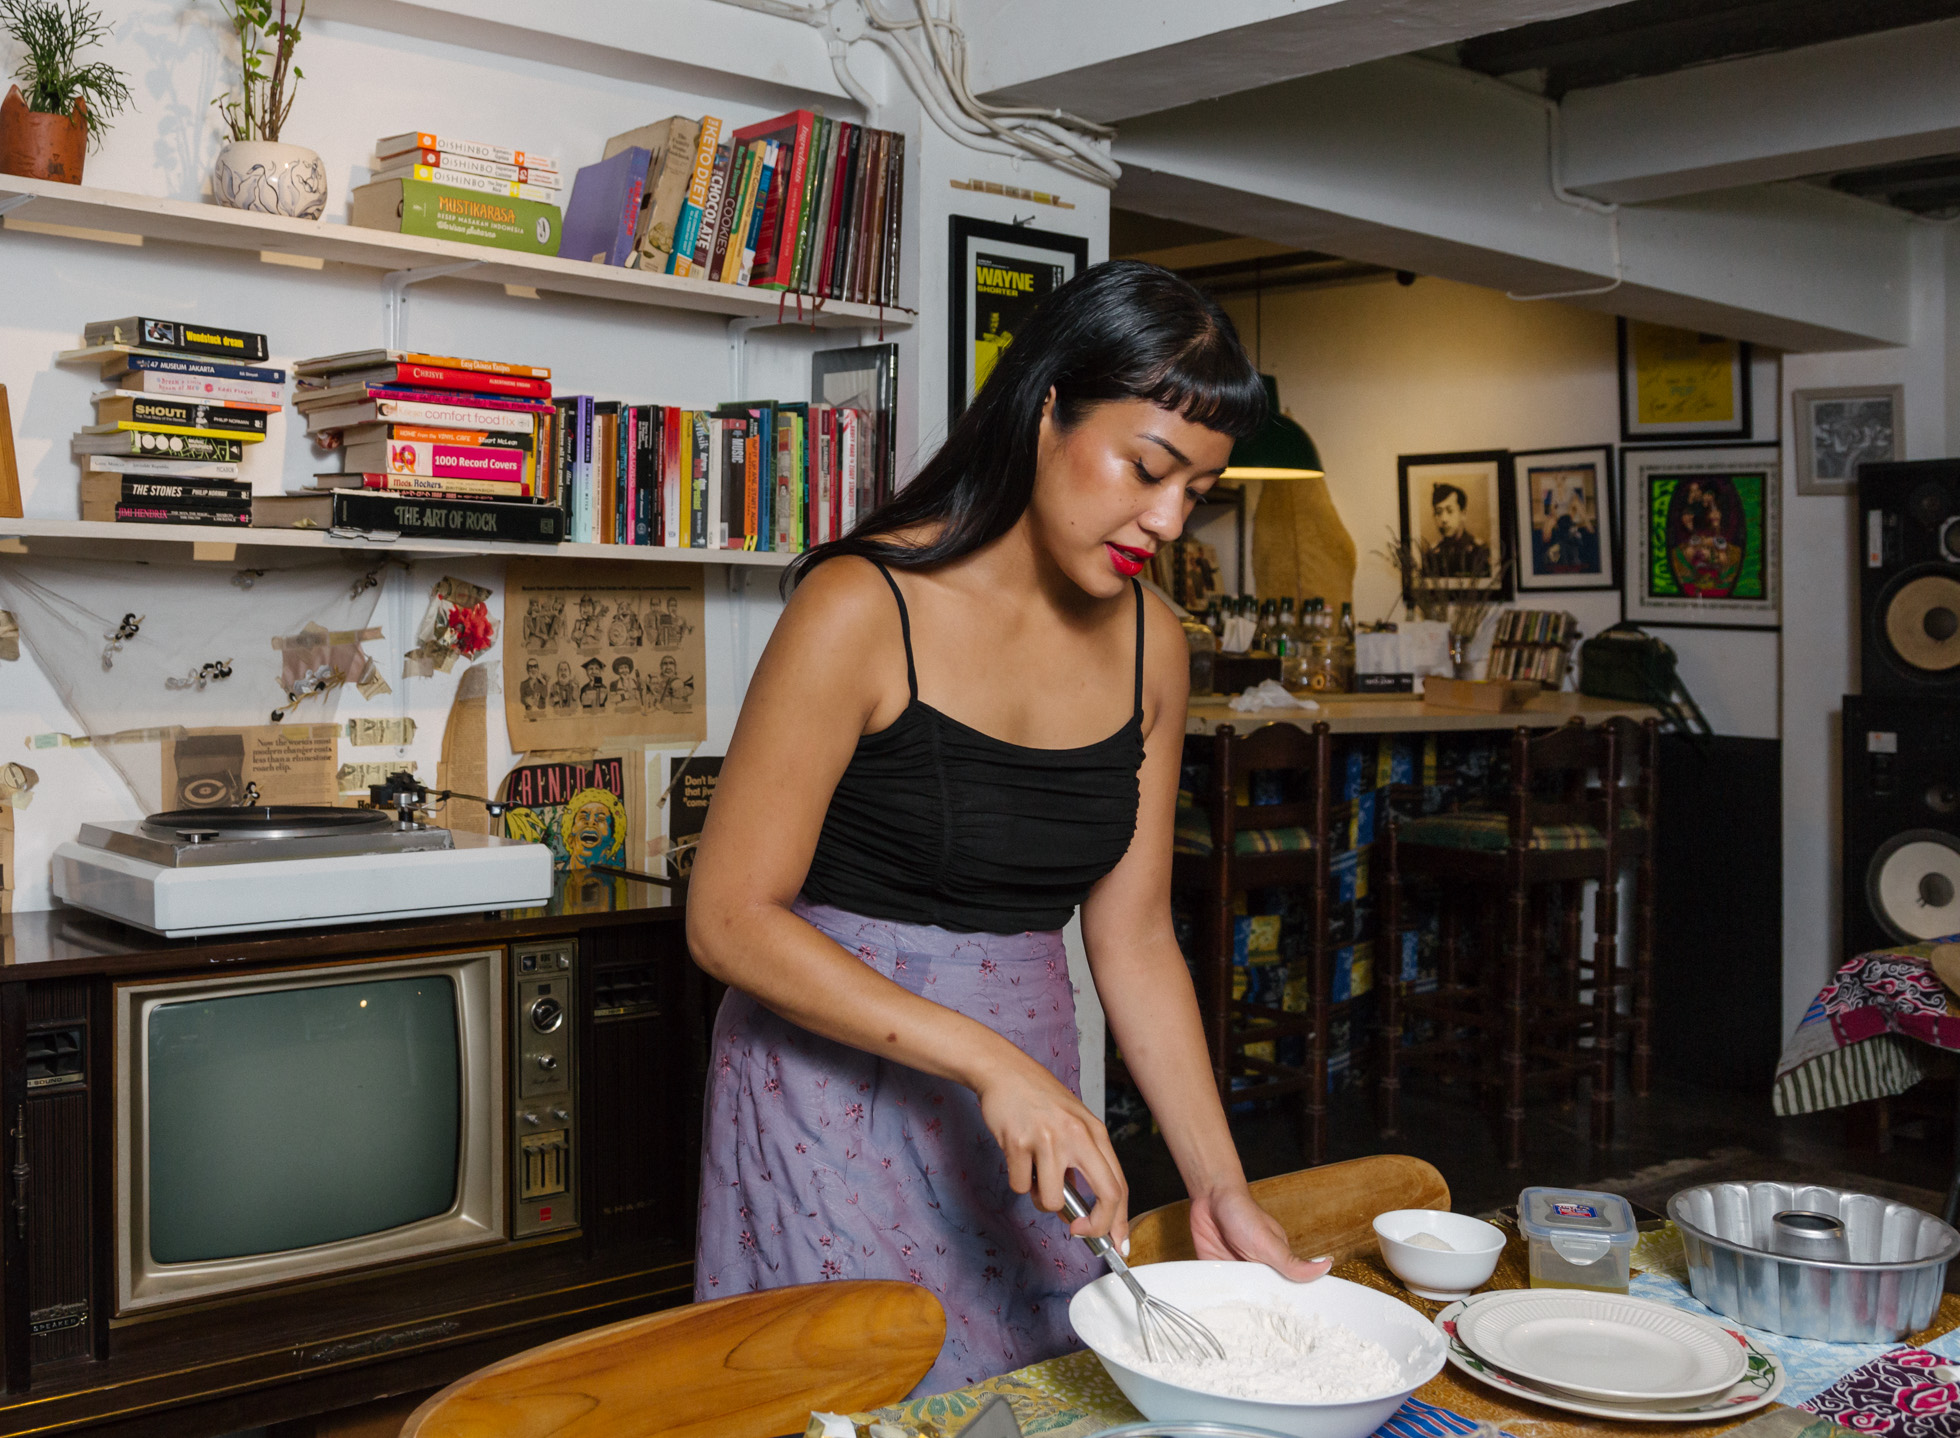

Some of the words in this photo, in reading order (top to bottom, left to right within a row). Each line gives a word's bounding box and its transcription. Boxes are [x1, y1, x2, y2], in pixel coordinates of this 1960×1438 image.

[700, 125, 718, 166] KETO
[795, 125, 809, 184] Ingredients
[754, 155, 764, 176] FOOD
[692, 168, 710, 205] DIET
[438, 195, 516, 224] MUSTIKARASA
[701, 174, 724, 251] CHOCOLATE
[491, 223, 524, 234] INDONESIA
[716, 197, 736, 256] COOKIES
[976, 265, 1034, 292] WAYNE
[977, 284, 1019, 297] SHORTER
[160, 362, 187, 372] MUSEUM
[188, 364, 215, 375] JAKARTA
[460, 359, 473, 371] Easy
[473, 360, 492, 371] Chinese
[492, 362, 511, 374] Recipes
[135, 403, 187, 419] SHOUT!
[424, 408, 472, 423] comfort
[474, 411, 501, 426] food
[501, 415, 516, 427] fix
[213, 416, 228, 424] PHILIP
[228, 418, 250, 426] NORMAN
[399, 429, 416, 438] HOME
[477, 436, 497, 444] Stuart
[497, 437, 518, 446] McLean
[731, 438, 744, 464] MUSIC
[434, 455, 458, 467] 1000
[458, 456, 489, 469] Record
[489, 458, 518, 471] Covers
[132, 484, 149, 496] THE
[150, 484, 183, 498] STONES
[117, 507, 133, 520] JIMI
[133, 508, 168, 520] HENDRIX
[394, 505, 421, 528] THE
[422, 507, 447, 528] ART
[449, 510, 464, 530] OF
[465, 512, 498, 532] ROCK
[252, 747, 283, 755] modern
[252, 755, 266, 763] less
[509, 761, 621, 807] TRINIDAD
[684, 775, 707, 786] Don't
[684, 787, 701, 797] that
[32, 1317, 77, 1332] SPEAKER
